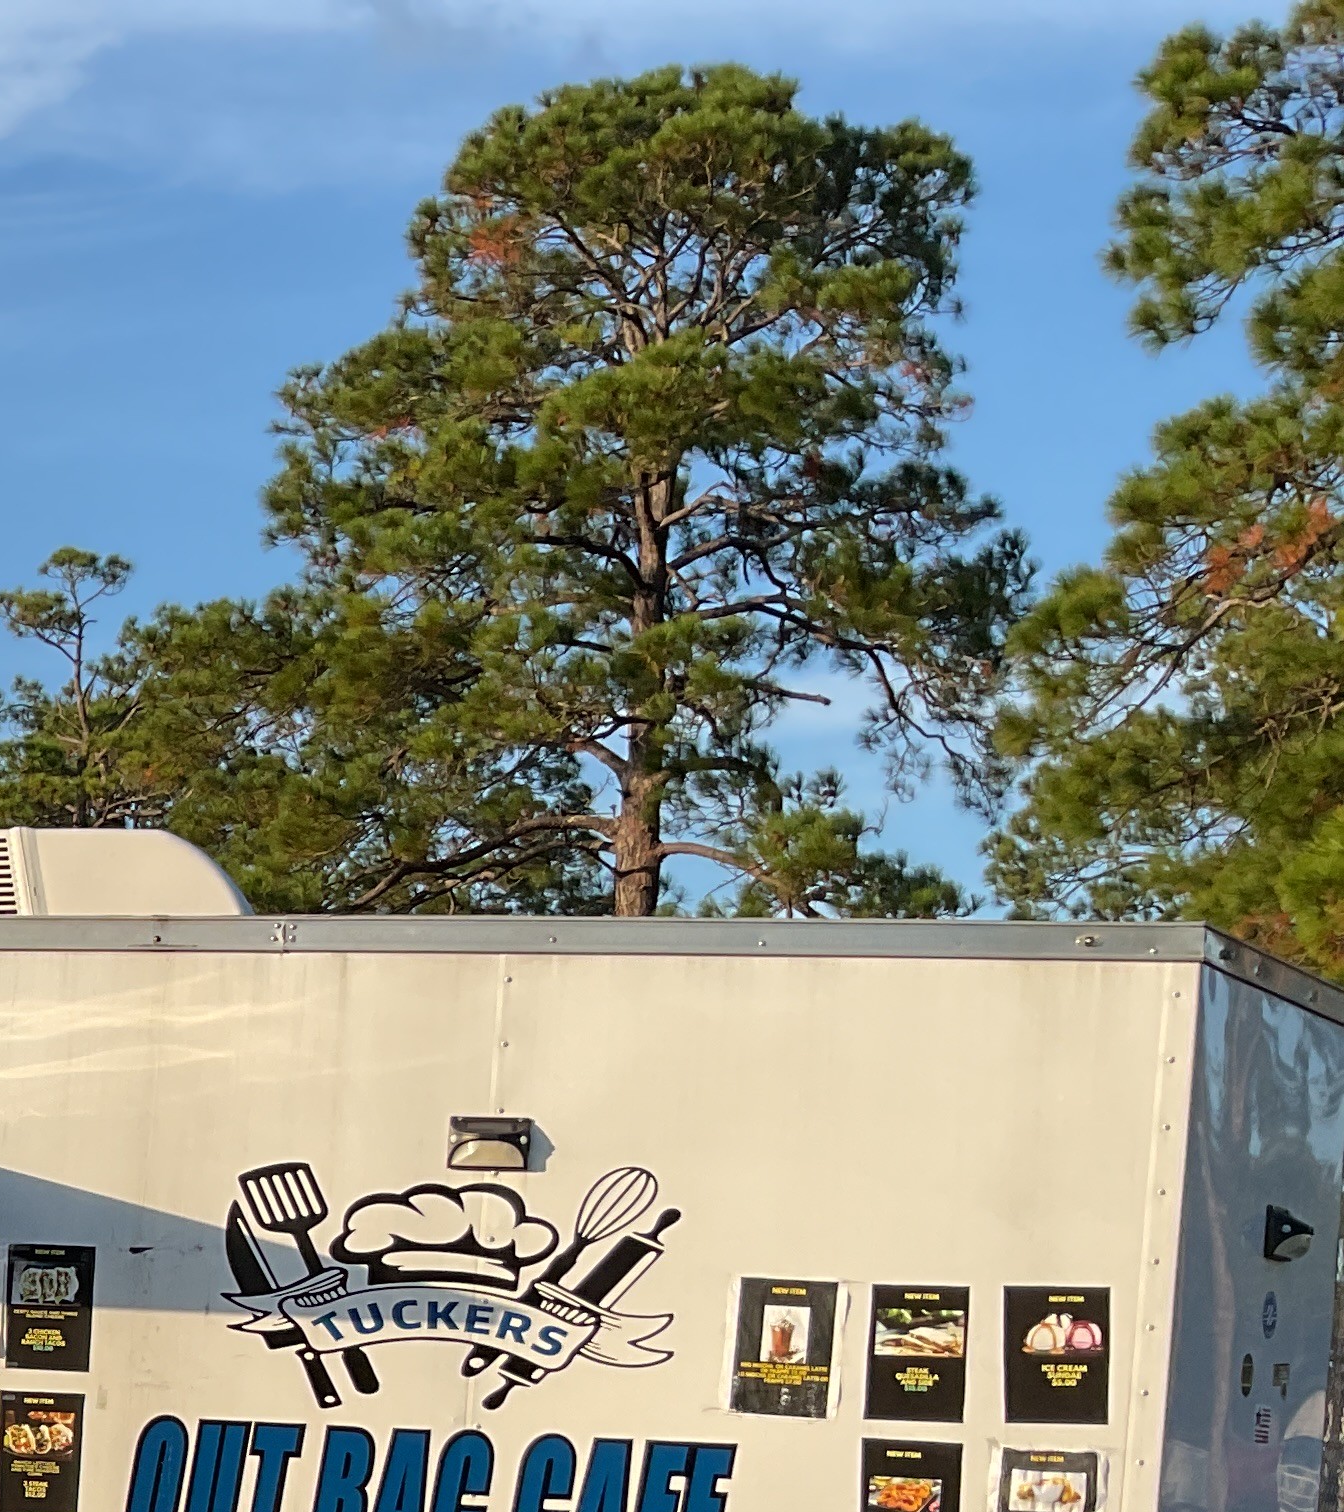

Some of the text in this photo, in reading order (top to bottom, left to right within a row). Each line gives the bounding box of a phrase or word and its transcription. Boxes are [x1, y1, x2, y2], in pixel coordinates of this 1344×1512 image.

[312, 1299, 570, 1356] TUCKERS
[1041, 1364, 1087, 1372] ICE CREAM
